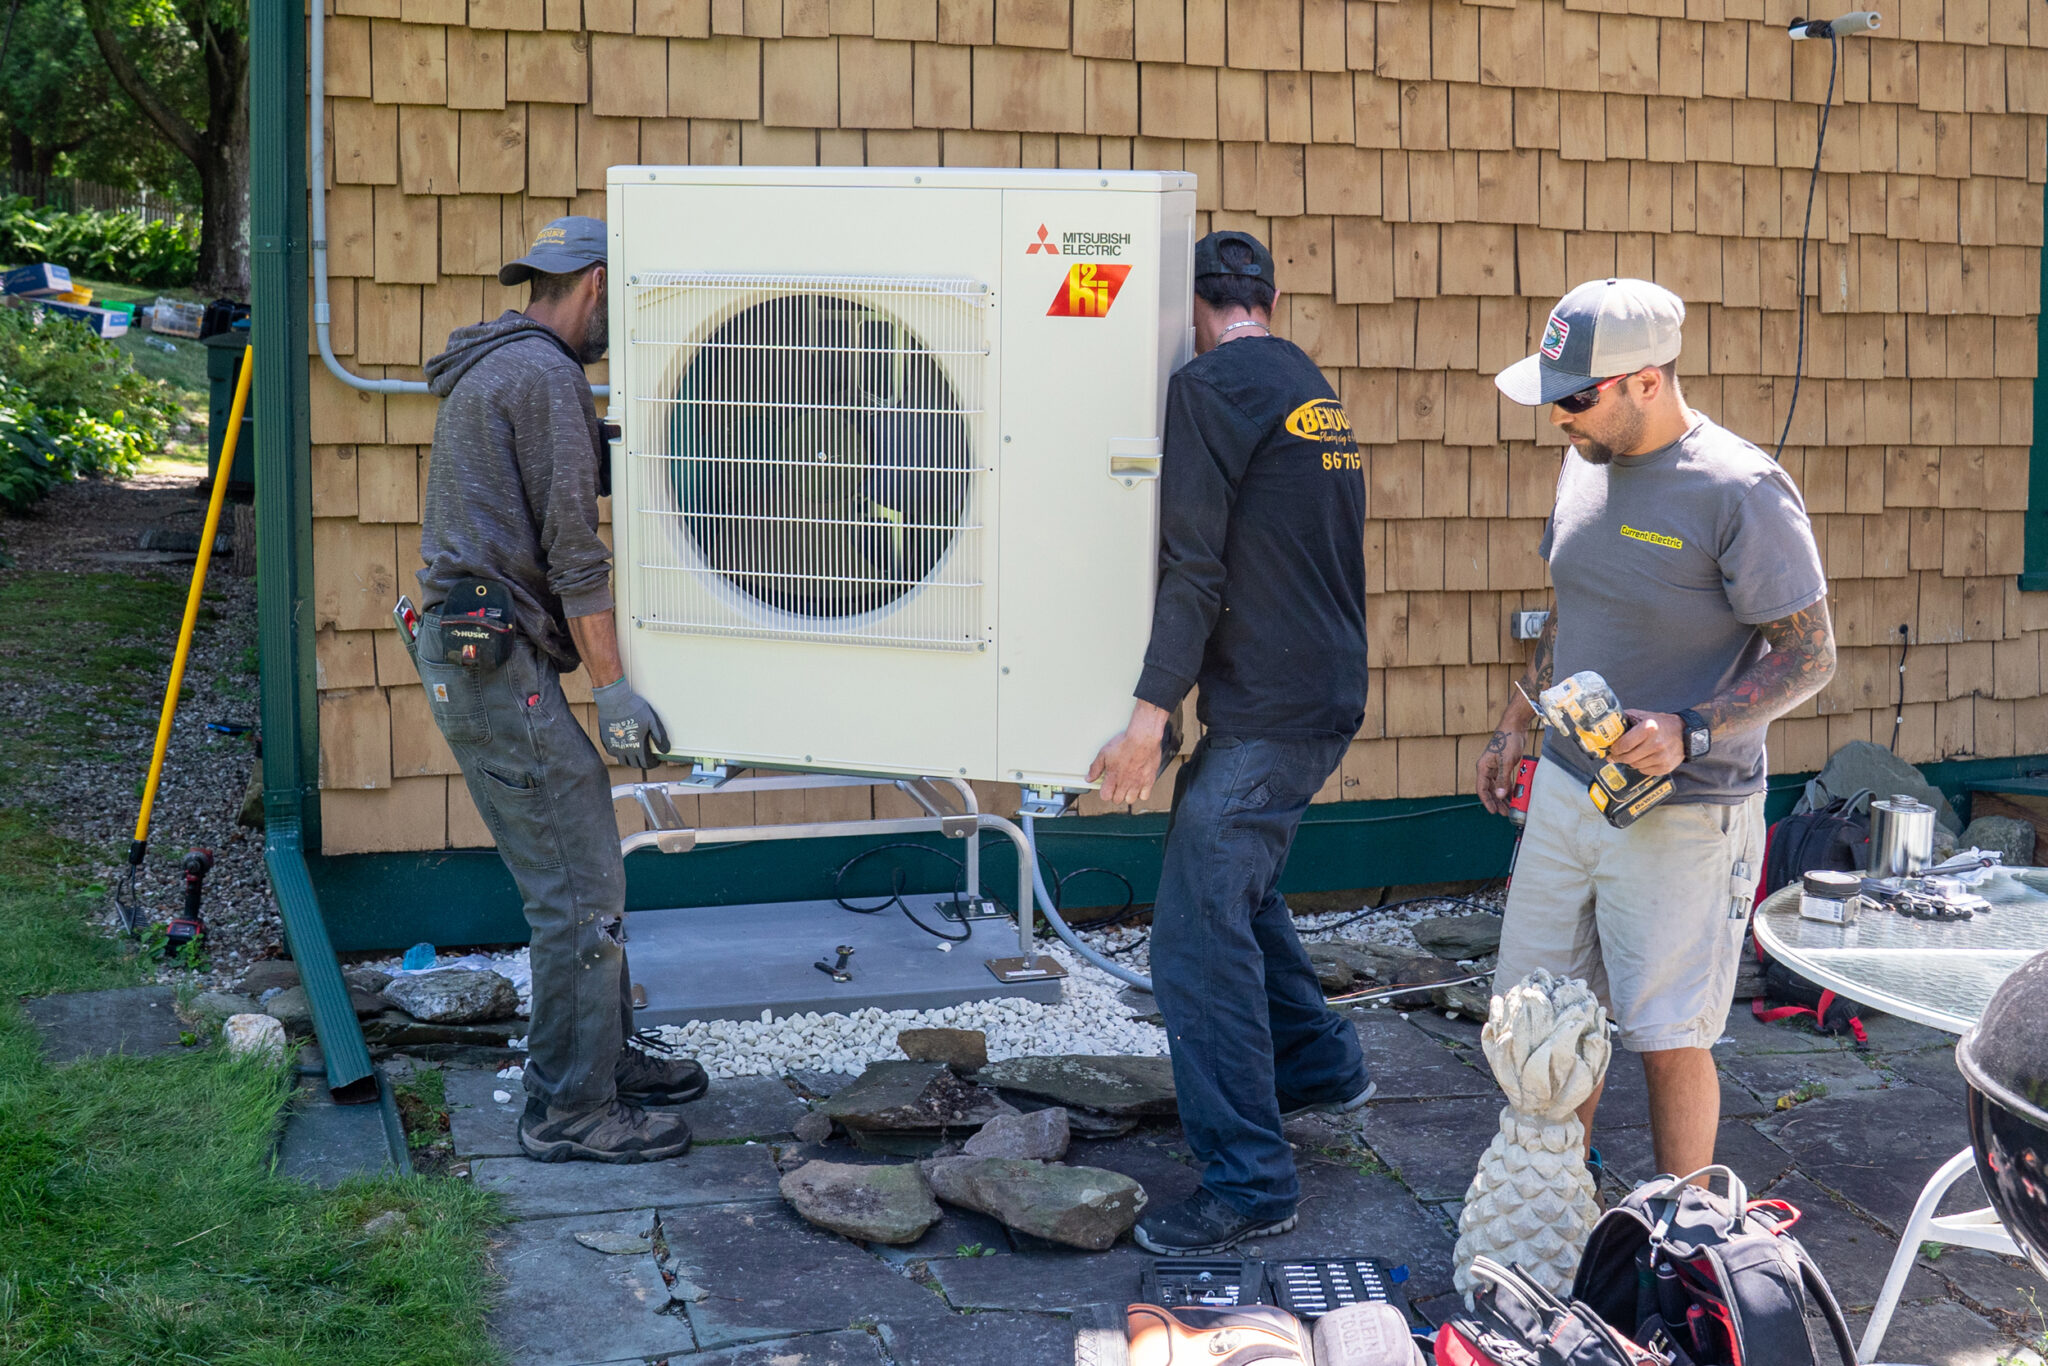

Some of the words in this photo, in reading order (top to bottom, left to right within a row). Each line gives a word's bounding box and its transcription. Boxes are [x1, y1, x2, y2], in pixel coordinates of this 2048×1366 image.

[1063, 232, 1131, 245] MITSUBISHI
[1063, 244, 1122, 256] ELECTRIC
[1621, 525, 1649, 541] Current
[1649, 532, 1683, 549] Electric
[461, 630, 490, 640] HUSKY
